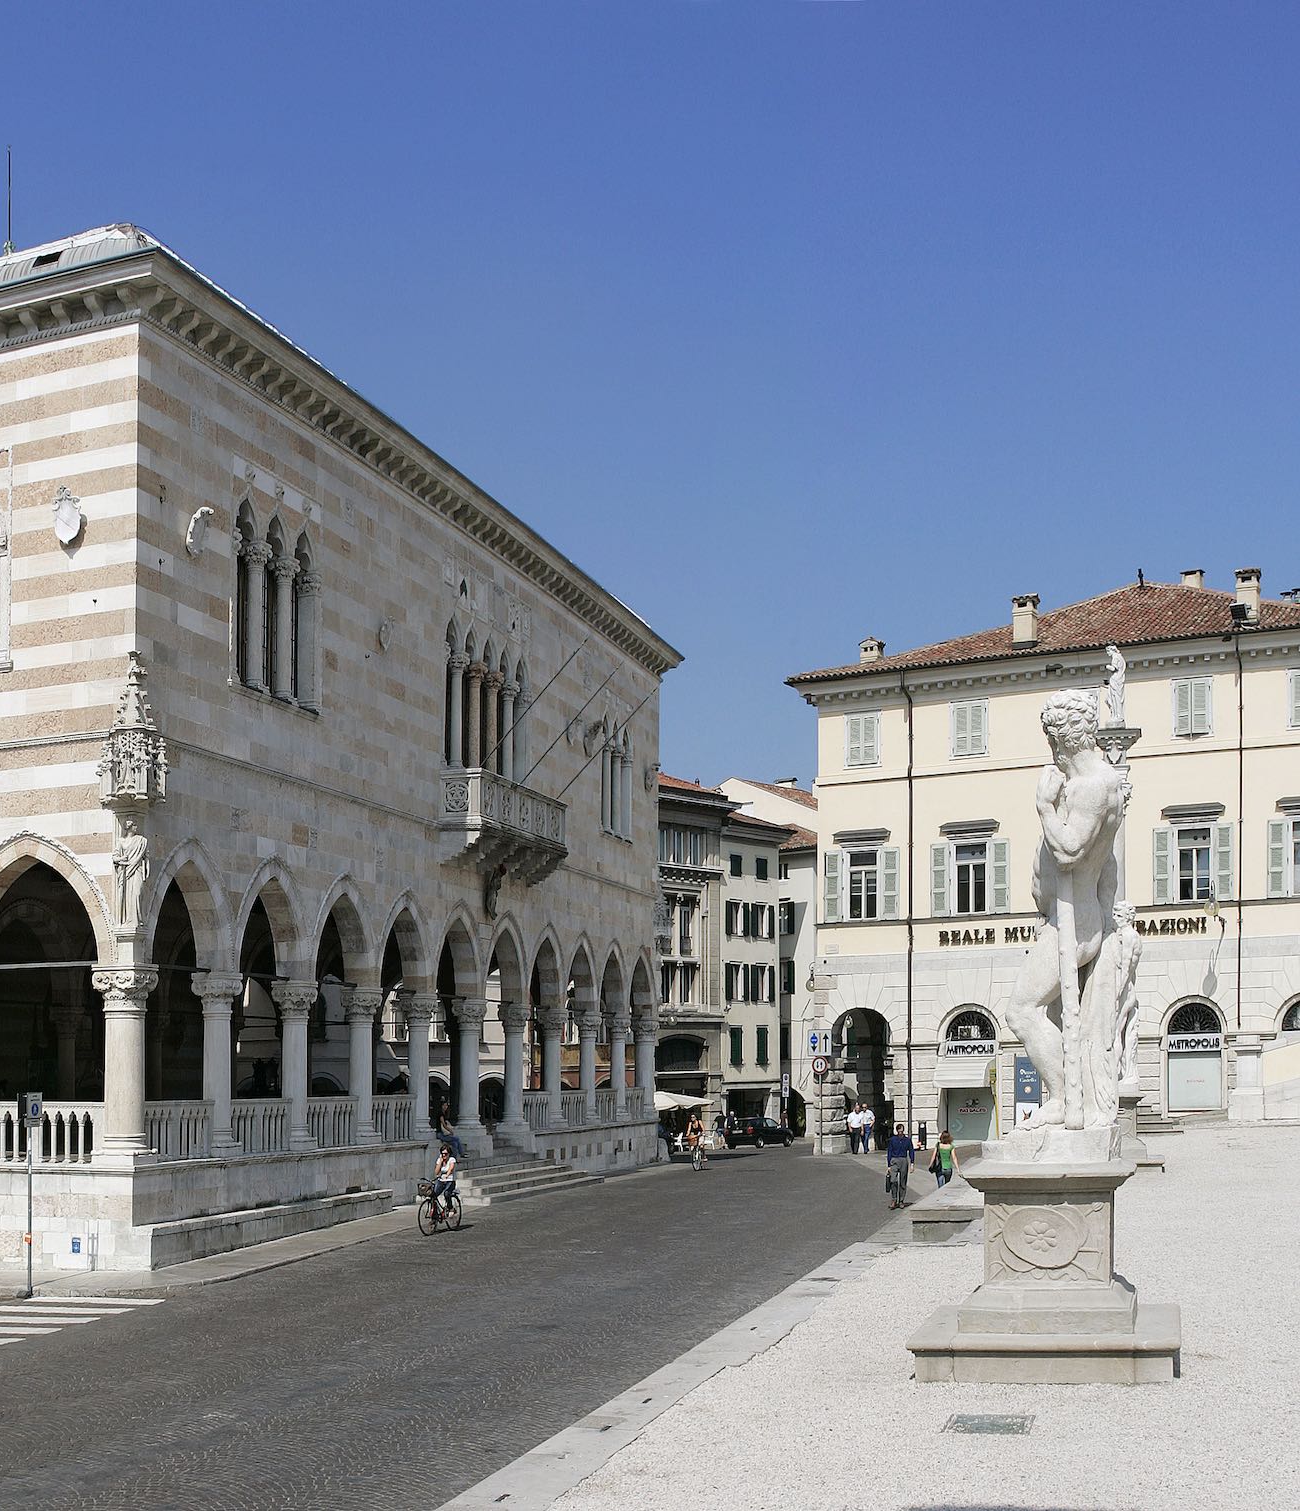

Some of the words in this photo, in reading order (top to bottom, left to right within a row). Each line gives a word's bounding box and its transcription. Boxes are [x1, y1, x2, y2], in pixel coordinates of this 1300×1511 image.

[938, 928, 996, 946] REALE
[1132, 916, 1207, 937] RAZIONI
[946, 1044, 995, 1055] METROPOLIS
[1169, 1037, 1220, 1050] METROPOLIS
